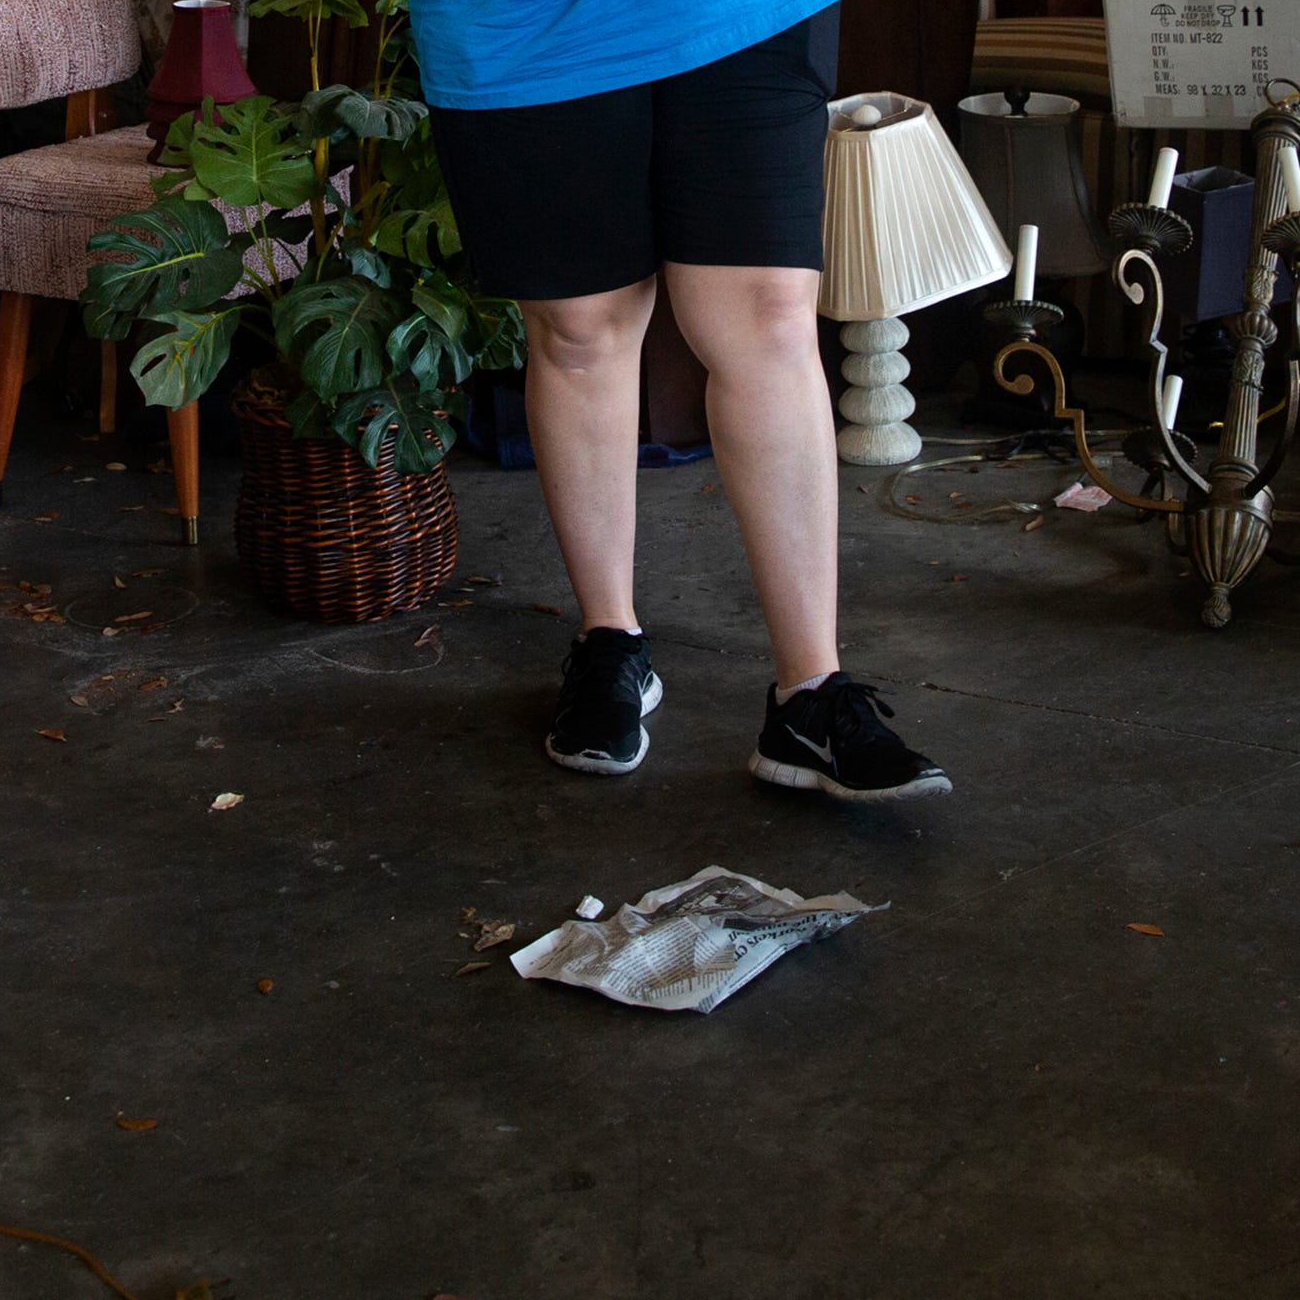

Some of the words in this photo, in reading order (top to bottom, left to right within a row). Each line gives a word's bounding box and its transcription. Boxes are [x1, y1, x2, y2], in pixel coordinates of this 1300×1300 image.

[1151, 33, 1170, 43] ITEM
[1190, 33, 1223, 44] MT-822
[1251, 46, 1268, 57] PCS
[1252, 60, 1269, 70] KGS
[1252, 73, 1269, 83] KGS
[1187, 85, 1198, 96] 98
[1211, 85, 1223, 96] 32
[1234, 85, 1247, 96] 23
